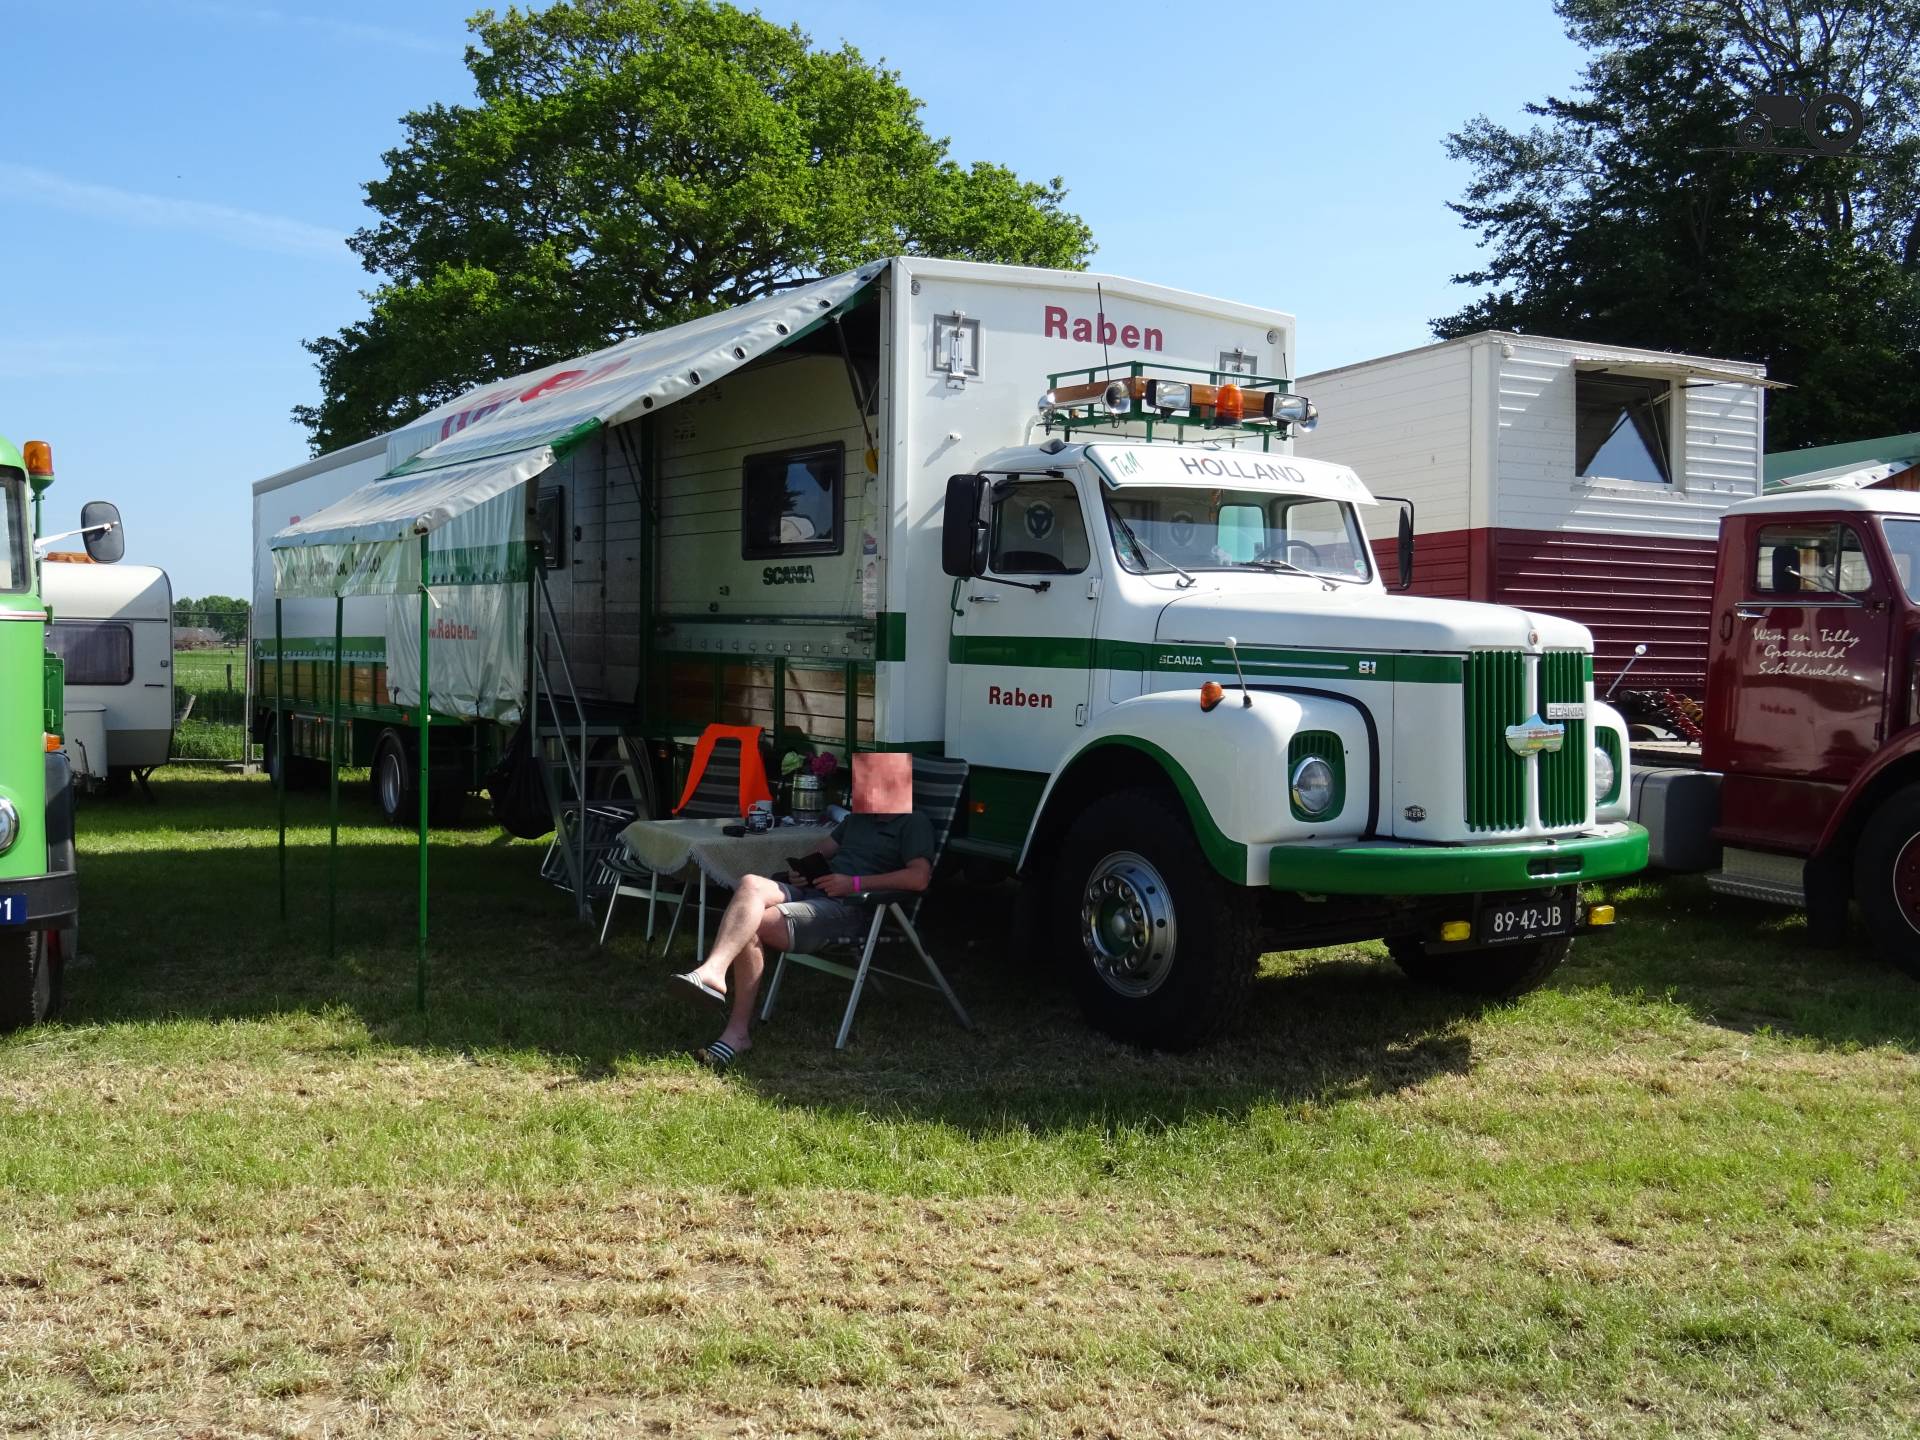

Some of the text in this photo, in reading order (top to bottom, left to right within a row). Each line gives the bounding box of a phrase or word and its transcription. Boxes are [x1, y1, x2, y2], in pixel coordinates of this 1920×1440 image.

[1044, 305, 1163, 352] Raben
[1180, 456, 1306, 483] HOLLAND
[1753, 627, 1860, 648] Wim en Tilly
[1764, 644, 1846, 659] Groeneveld
[1159, 654, 1377, 675] SCANIA 81
[1758, 661, 1849, 677] Schildwolde
[989, 685, 1053, 709] Raben
[1549, 705, 1585, 717] SCANIA
[1493, 905, 1562, 933] 89-42-JB
